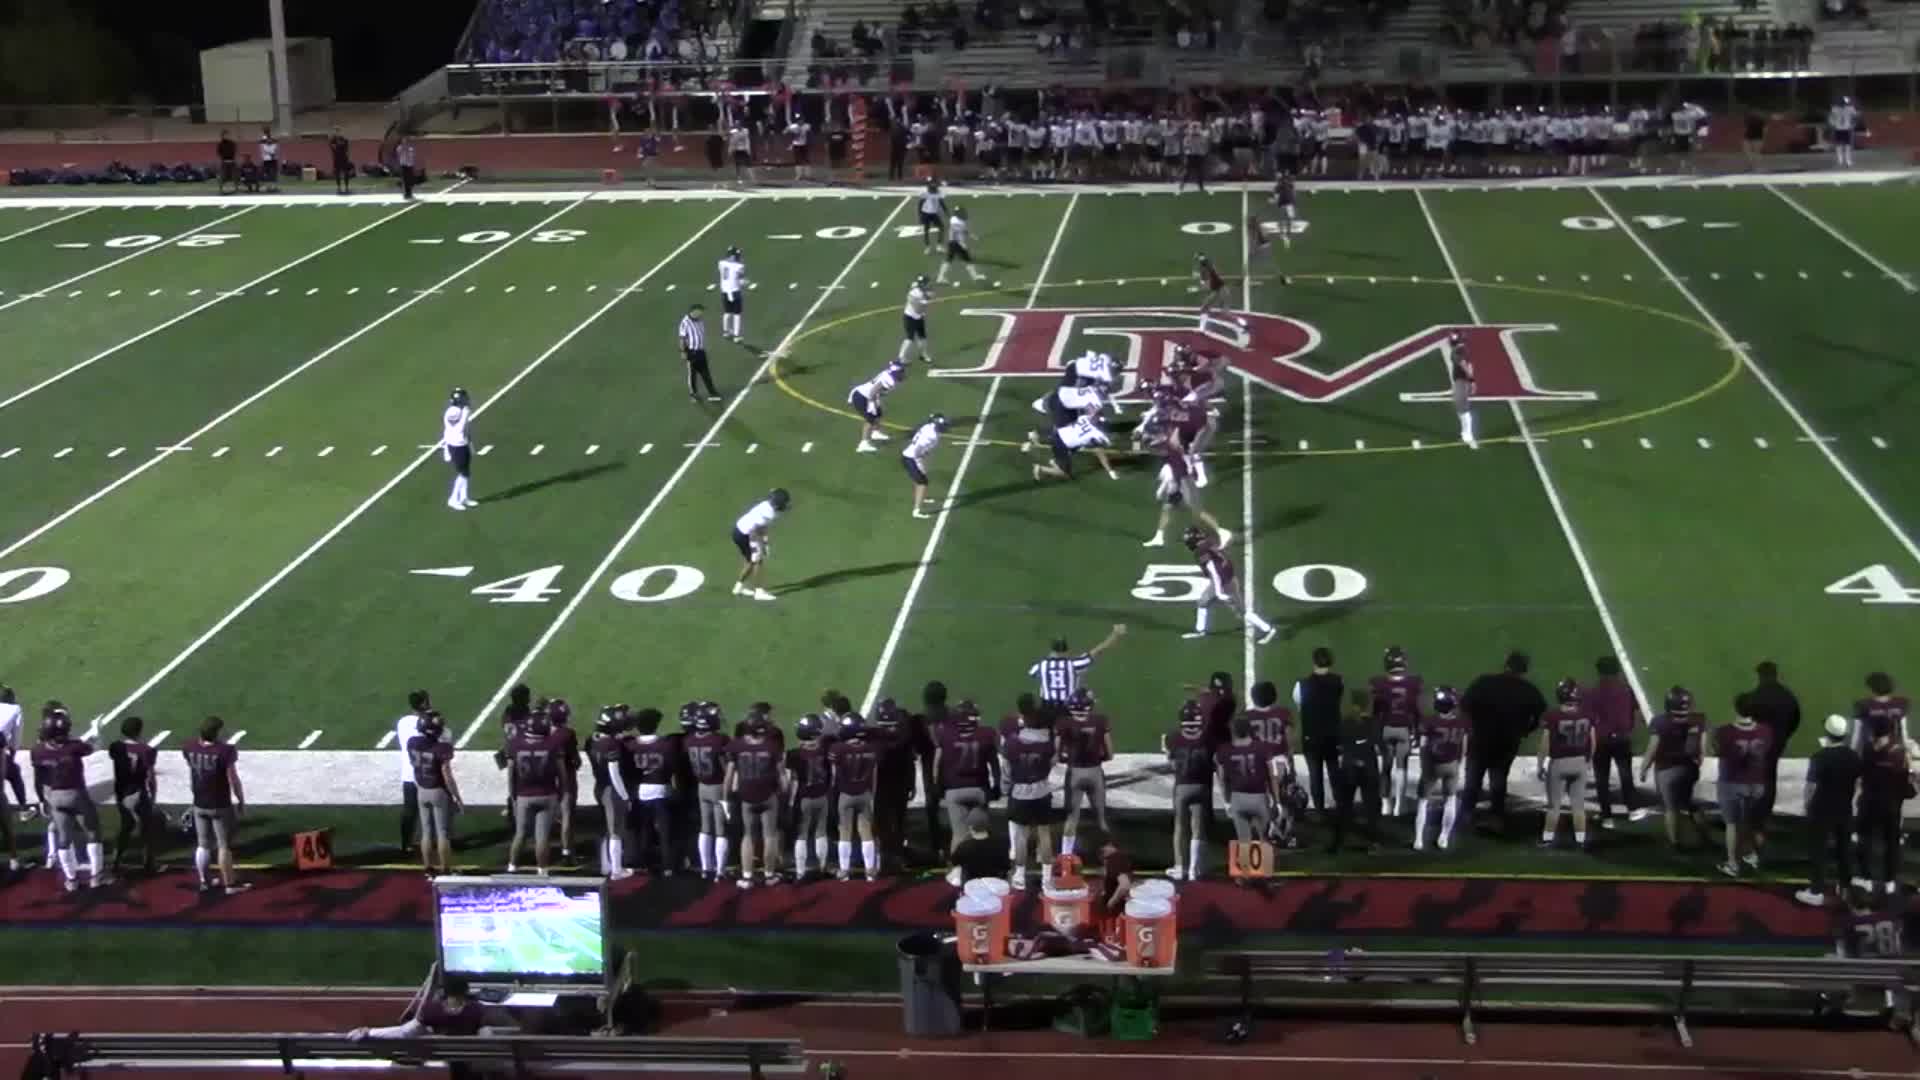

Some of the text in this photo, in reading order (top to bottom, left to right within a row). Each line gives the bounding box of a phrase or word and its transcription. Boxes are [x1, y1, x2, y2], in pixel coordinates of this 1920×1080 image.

[470, 565, 706, 603] 40
[1049, 670, 1066, 690] H
[972, 924, 988, 941] G
[1138, 926, 1154, 943] G
